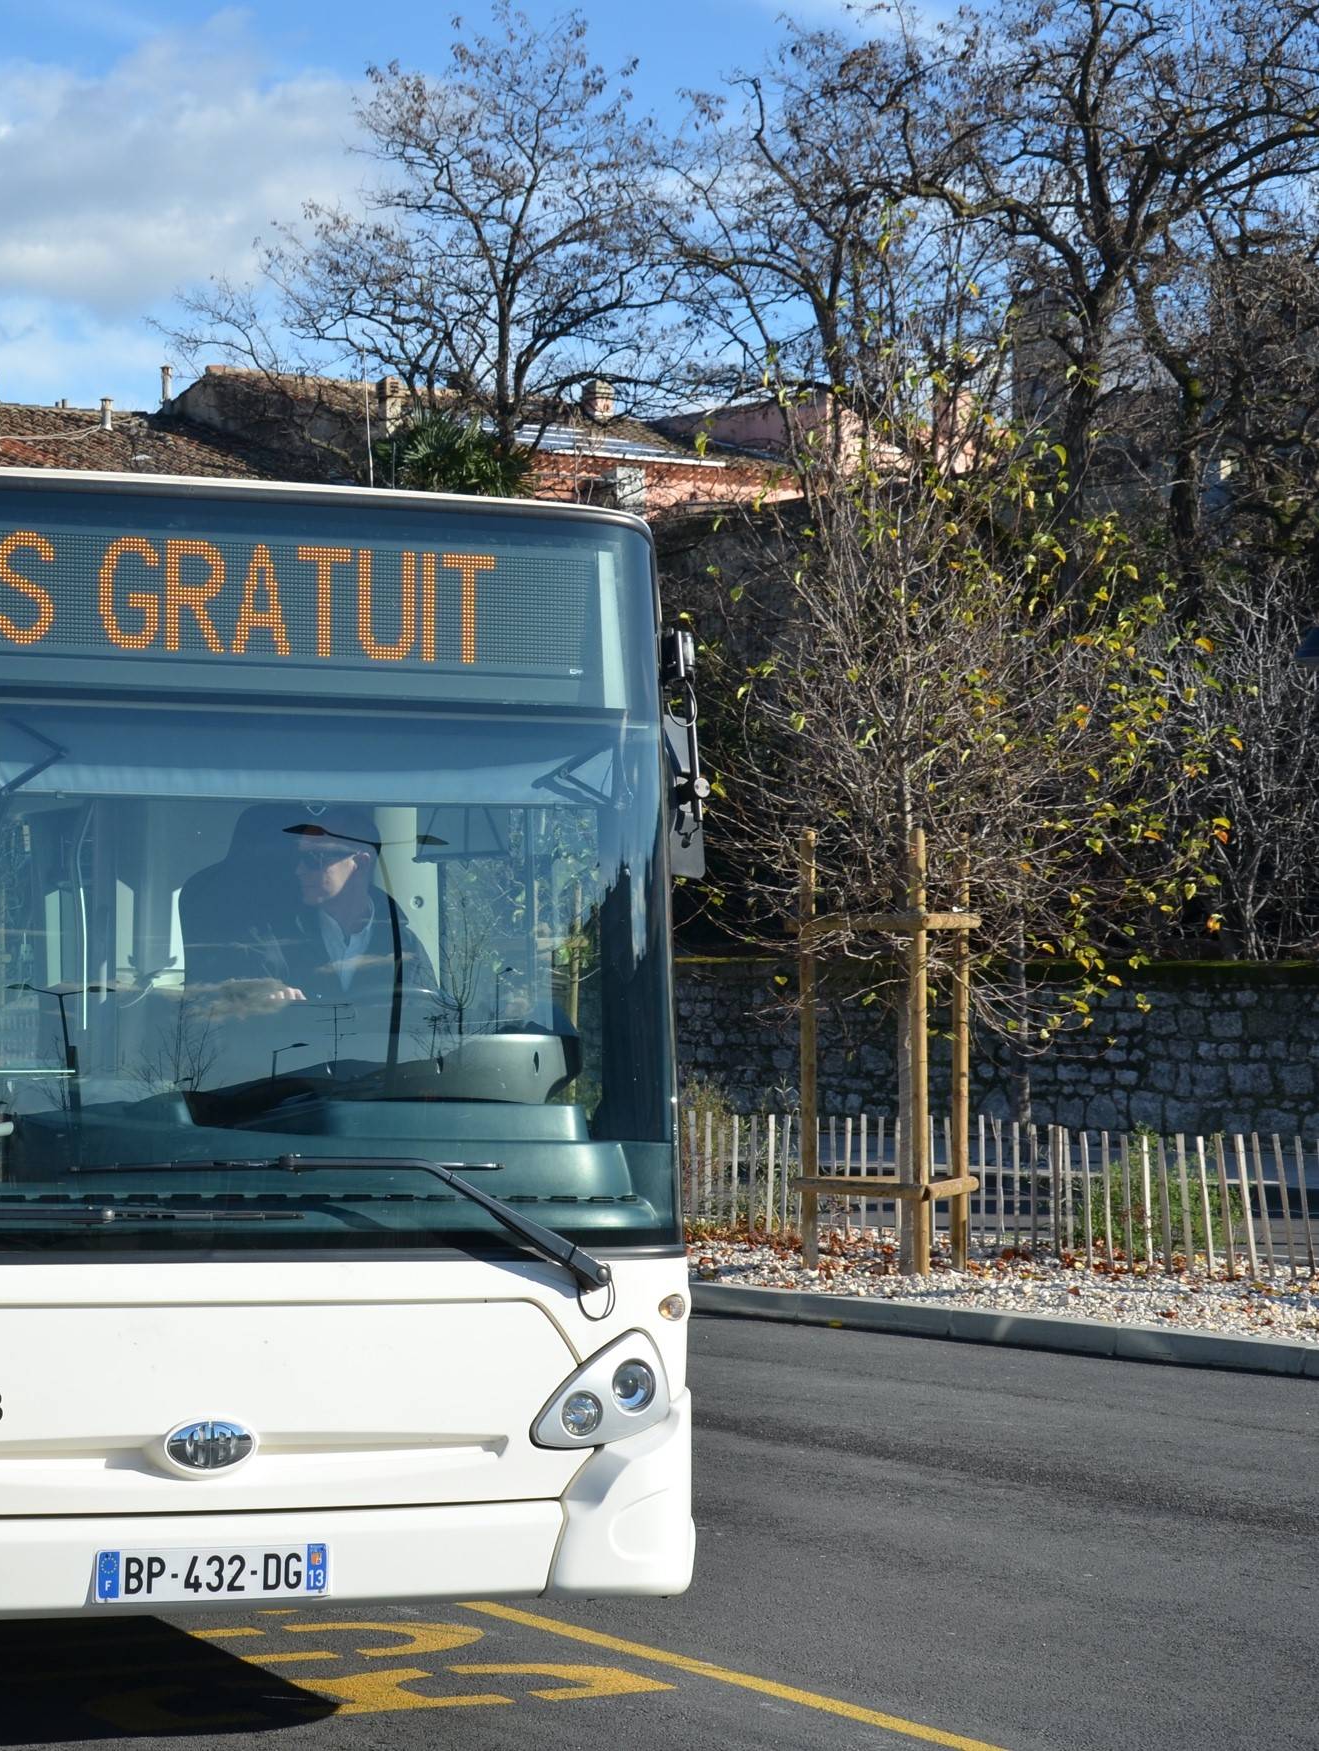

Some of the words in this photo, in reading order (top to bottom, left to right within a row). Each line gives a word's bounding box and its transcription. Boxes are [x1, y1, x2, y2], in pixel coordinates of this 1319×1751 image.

[98, 536, 495, 664] GRATUIT
[105, 1580, 112, 1591] F
[124, 1552, 302, 1595] BP-432-DG
[308, 1569, 324, 1588] 13
